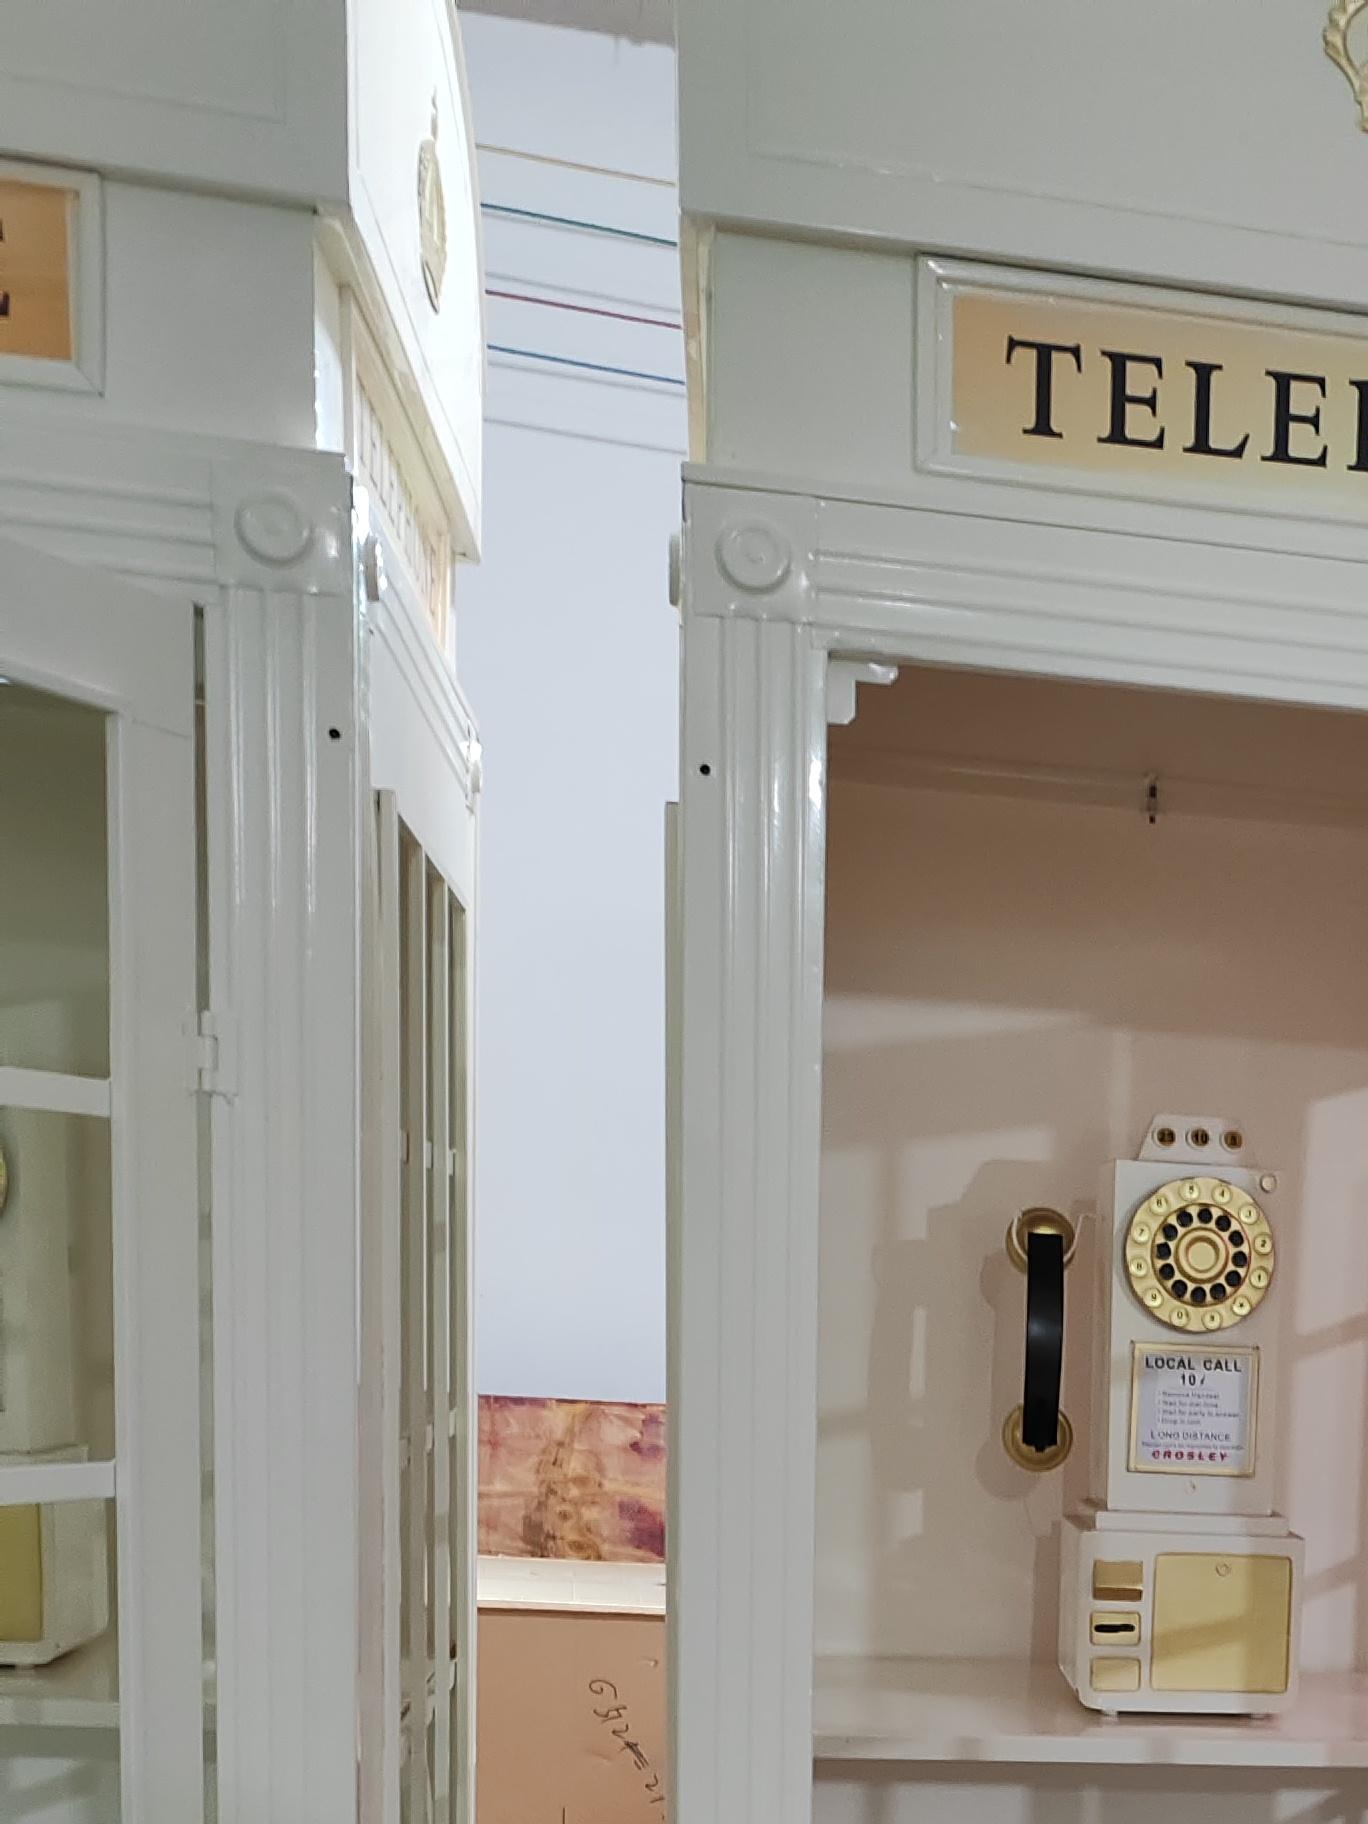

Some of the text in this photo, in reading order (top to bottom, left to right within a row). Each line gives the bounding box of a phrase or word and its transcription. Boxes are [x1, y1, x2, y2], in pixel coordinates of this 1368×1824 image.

[1145, 1355, 1242, 1372] LOCAL CALL
[1150, 1429, 1232, 1442] LONG DISTANCE
[1151, 1448, 1230, 1462] CROSLEY
